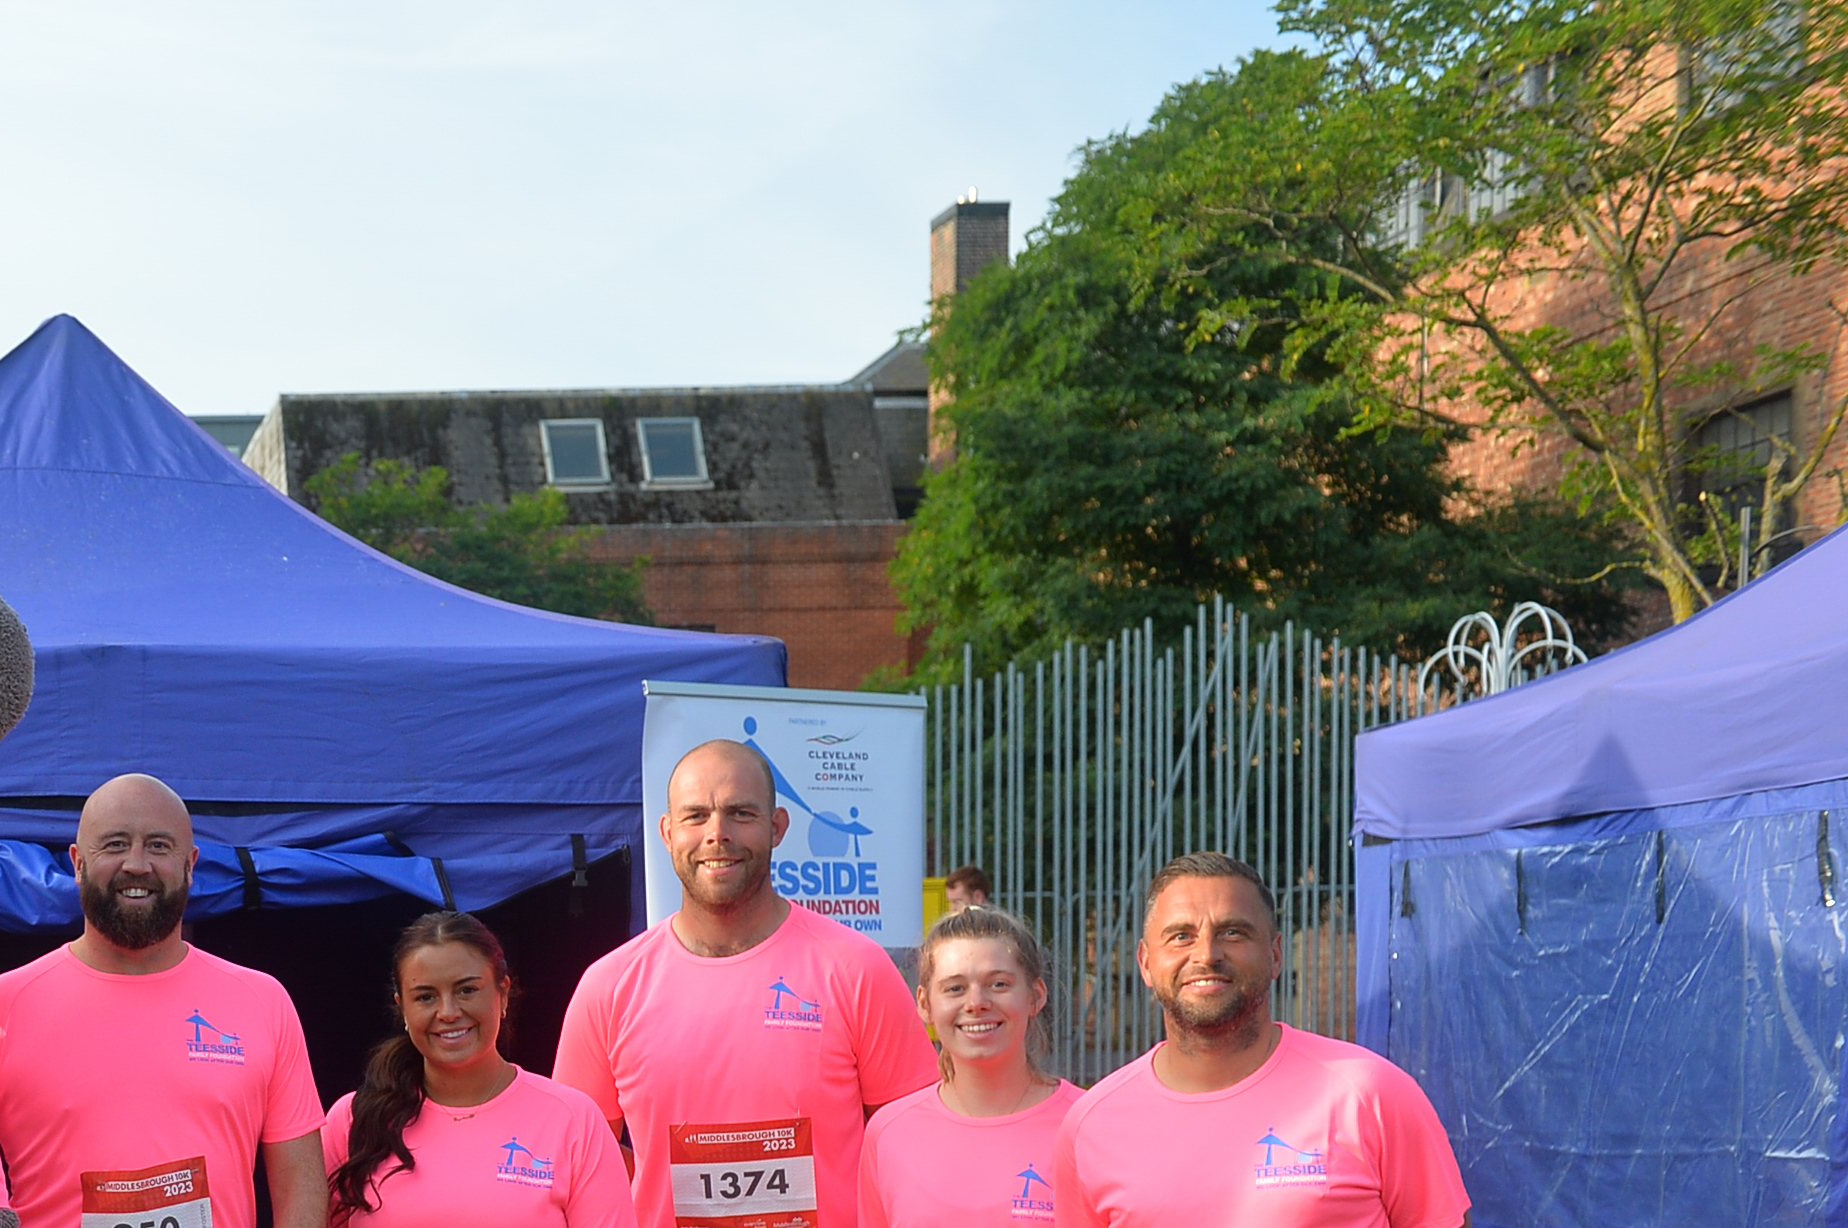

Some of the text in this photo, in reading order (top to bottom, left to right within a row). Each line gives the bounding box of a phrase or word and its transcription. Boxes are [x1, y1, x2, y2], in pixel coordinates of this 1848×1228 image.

[808, 750, 869, 761] CLEVELAND
[822, 762, 856, 771] CABLE
[814, 772, 864, 782] COMPANY
[854, 919, 882, 931] OWN
[765, 1010, 823, 1022] TEESSIDE
[186, 1042, 245, 1056] TEESSIDE
[699, 1129, 793, 1143] MIDDLESBROUGH 10K
[762, 1139, 796, 1152] 2023
[497, 1166, 554, 1179] TEESSIDE
[1254, 1165, 1327, 1178] TEESSIDE
[106, 1170, 191, 1191] MIDDLESBROUGH 10K
[699, 1168, 790, 1199] 1374
[163, 1181, 194, 1197] 2023
